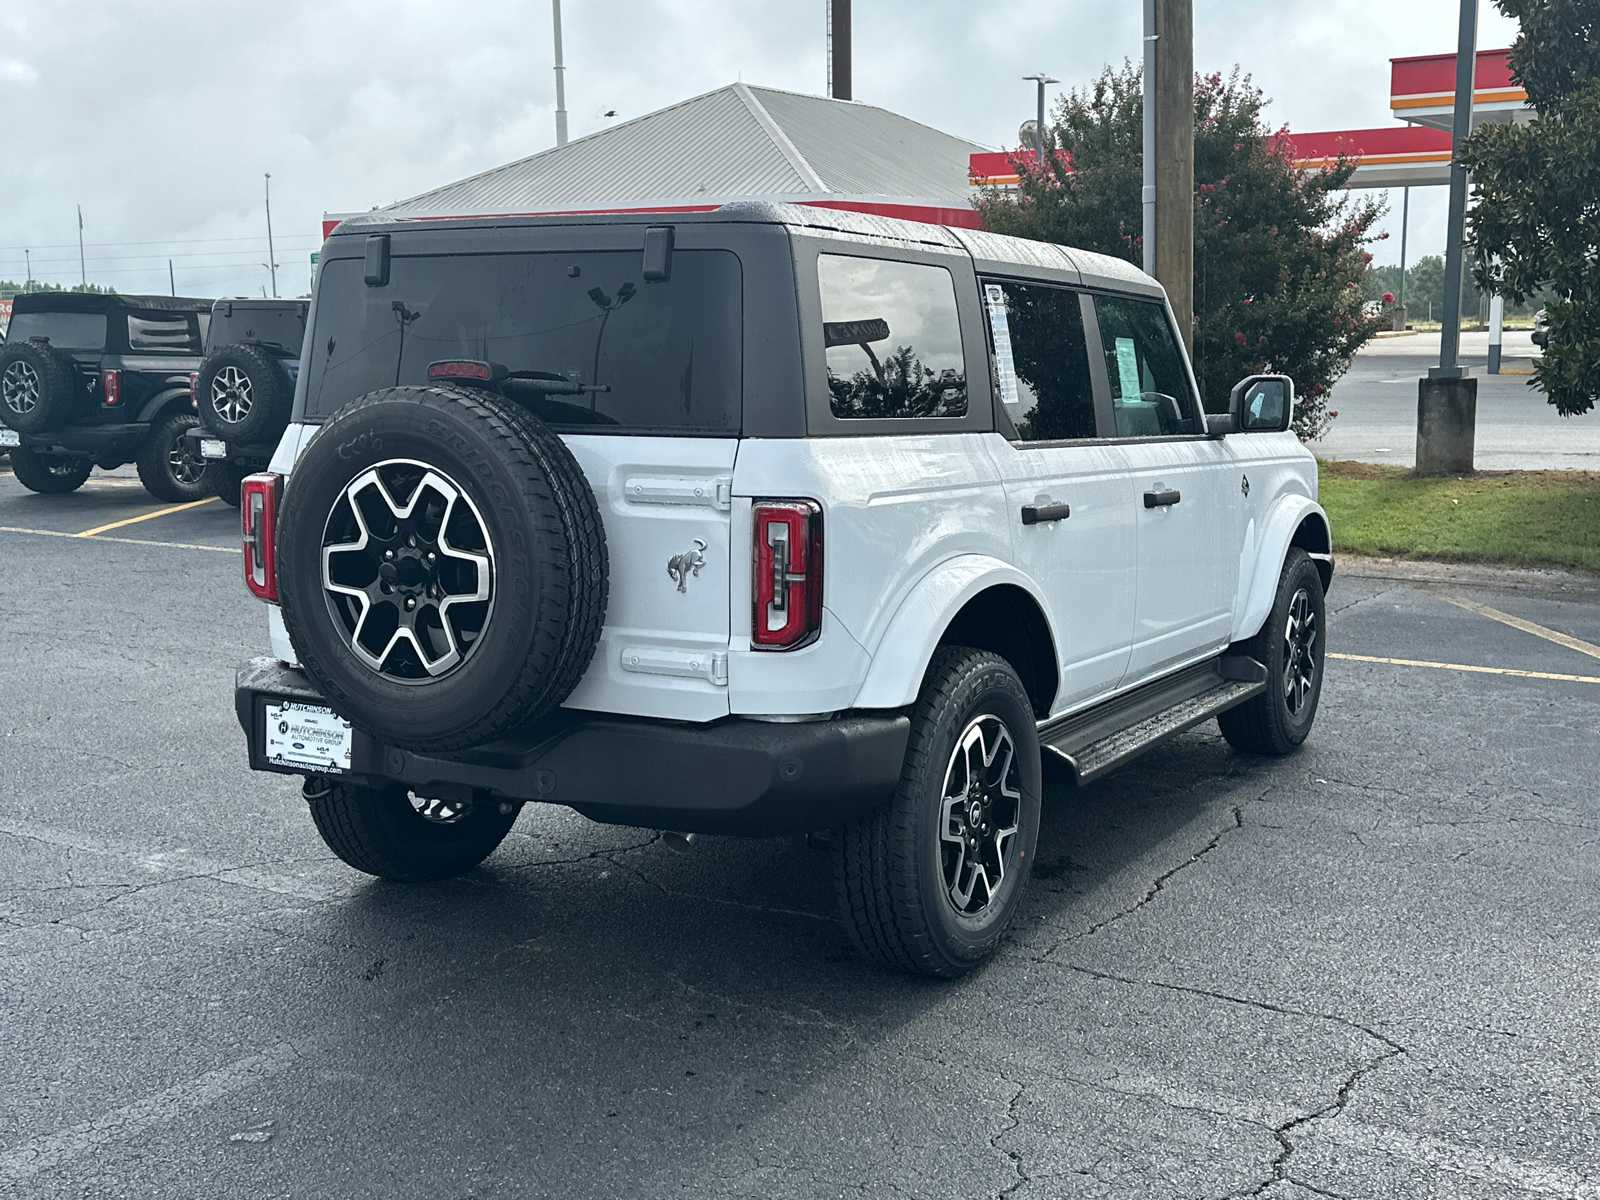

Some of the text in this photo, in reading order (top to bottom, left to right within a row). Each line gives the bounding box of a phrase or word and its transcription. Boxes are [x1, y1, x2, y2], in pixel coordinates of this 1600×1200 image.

[422, 419, 532, 652] BRIDGESTONE
[290, 702, 332, 715] HUTCHINSON
[291, 733, 342, 746] AUTOMOTIVE GROUP
